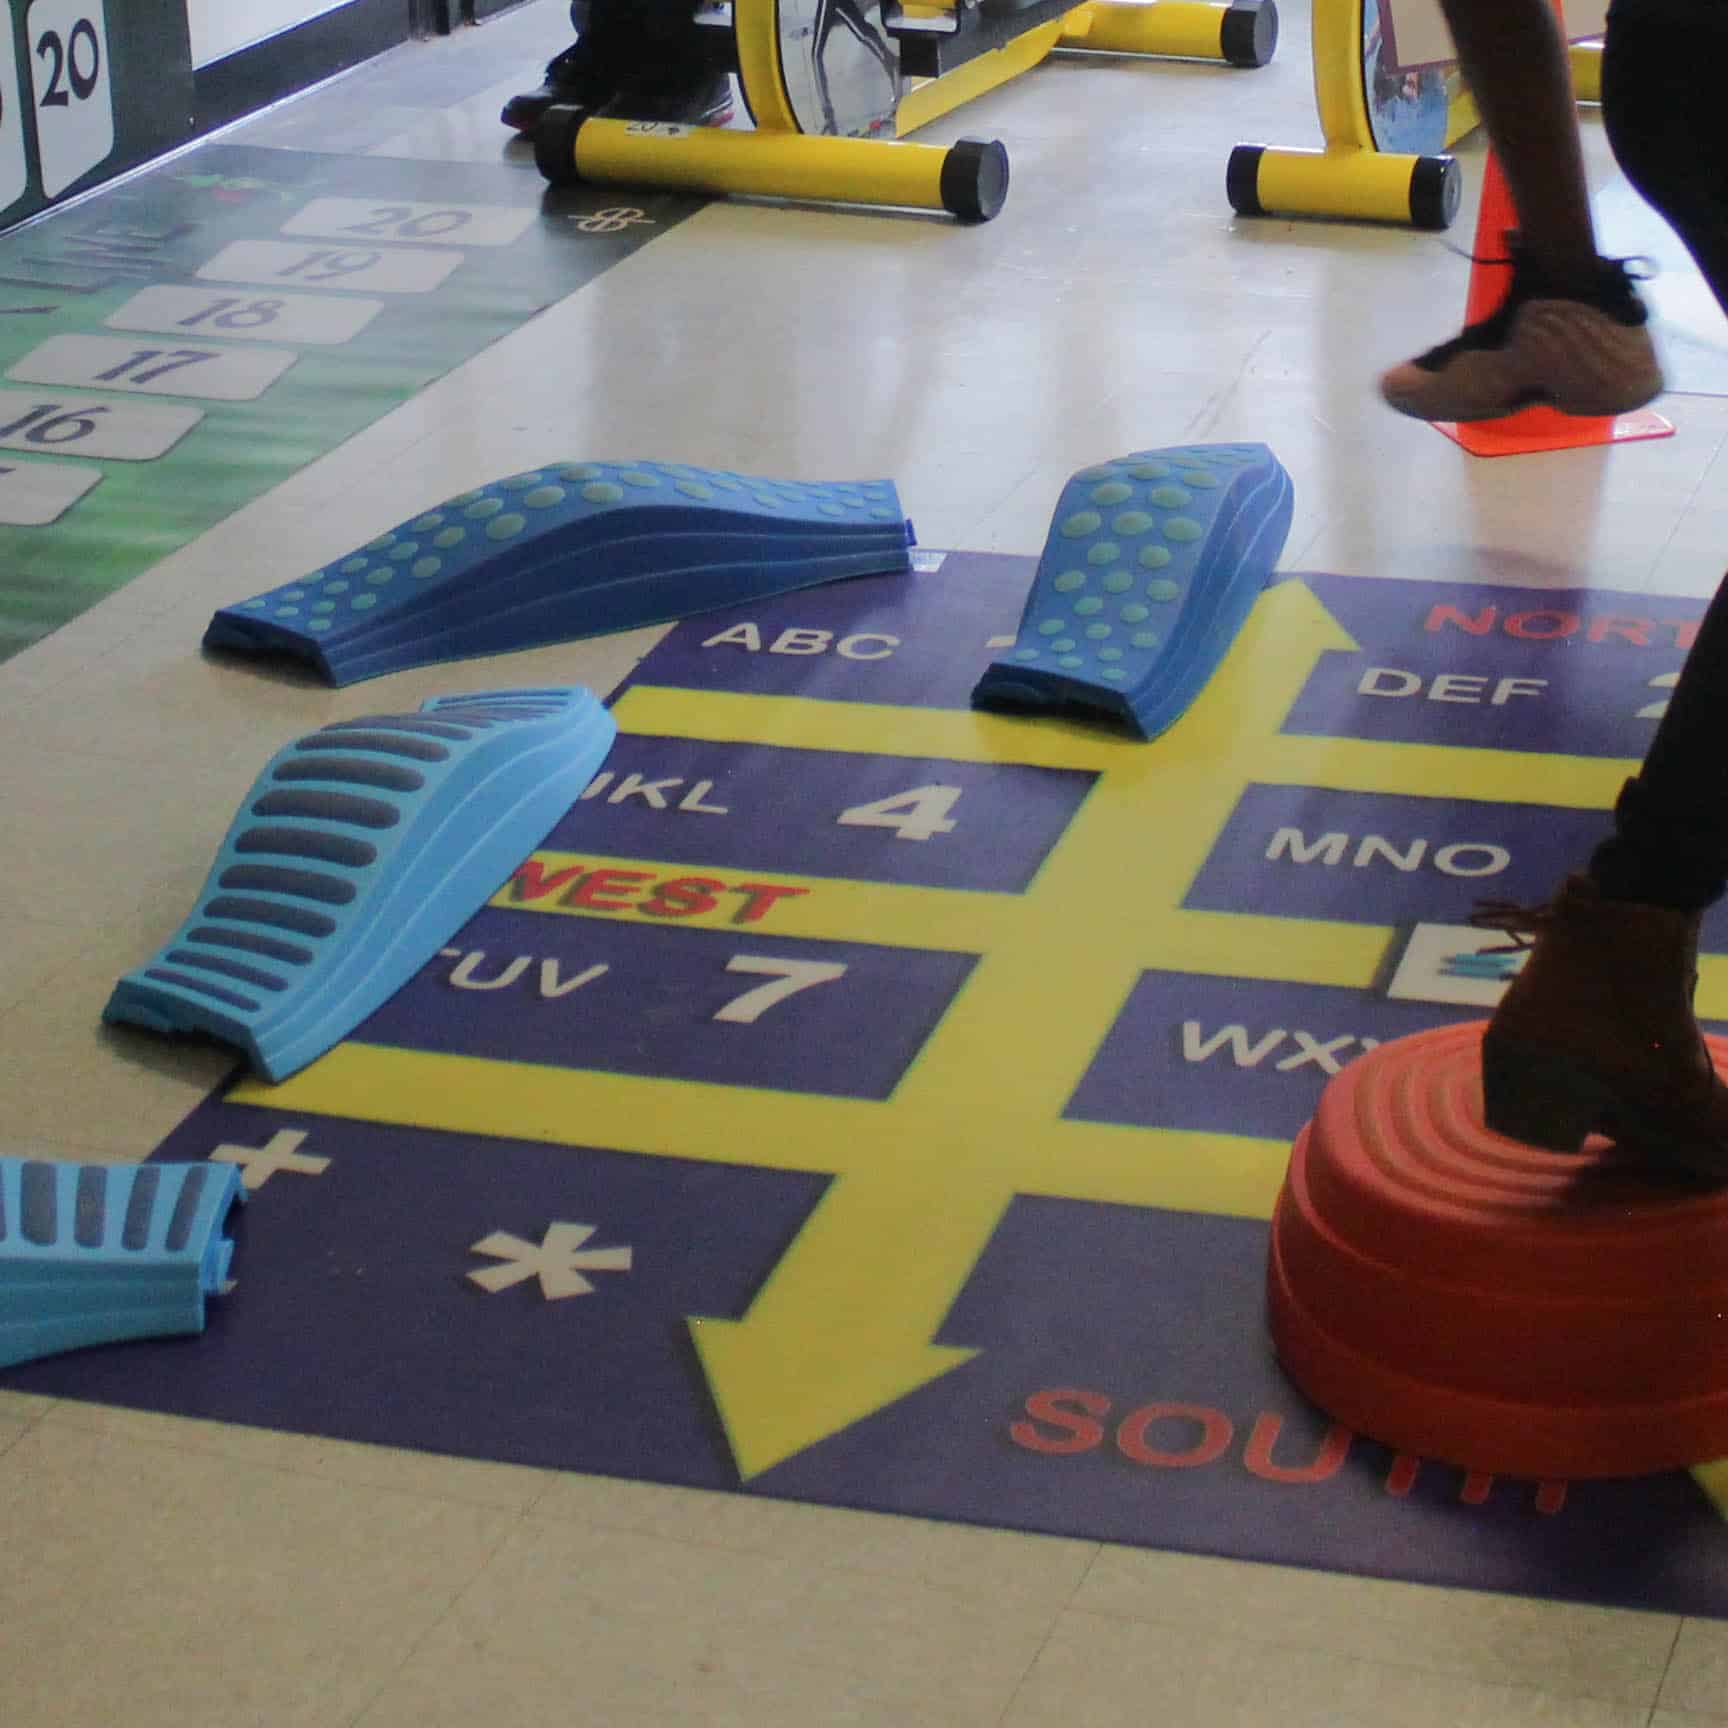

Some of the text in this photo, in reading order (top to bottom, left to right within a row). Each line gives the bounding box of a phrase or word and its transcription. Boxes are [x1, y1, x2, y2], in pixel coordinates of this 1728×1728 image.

[36, 18, 99, 108] 20
[344, 207, 473, 238] 20
[277, 250, 385, 281] 19
[176, 298, 286, 331] 18
[95, 350, 219, 386] 17
[703, 621, 901, 662] ABC
[1424, 604, 1704, 650] NORT
[1357, 667, 1550, 705] DEF
[836, 784, 962, 841] 4
[1266, 826, 1512, 878] MNO
[440, 947, 849, 1025] UV 7
